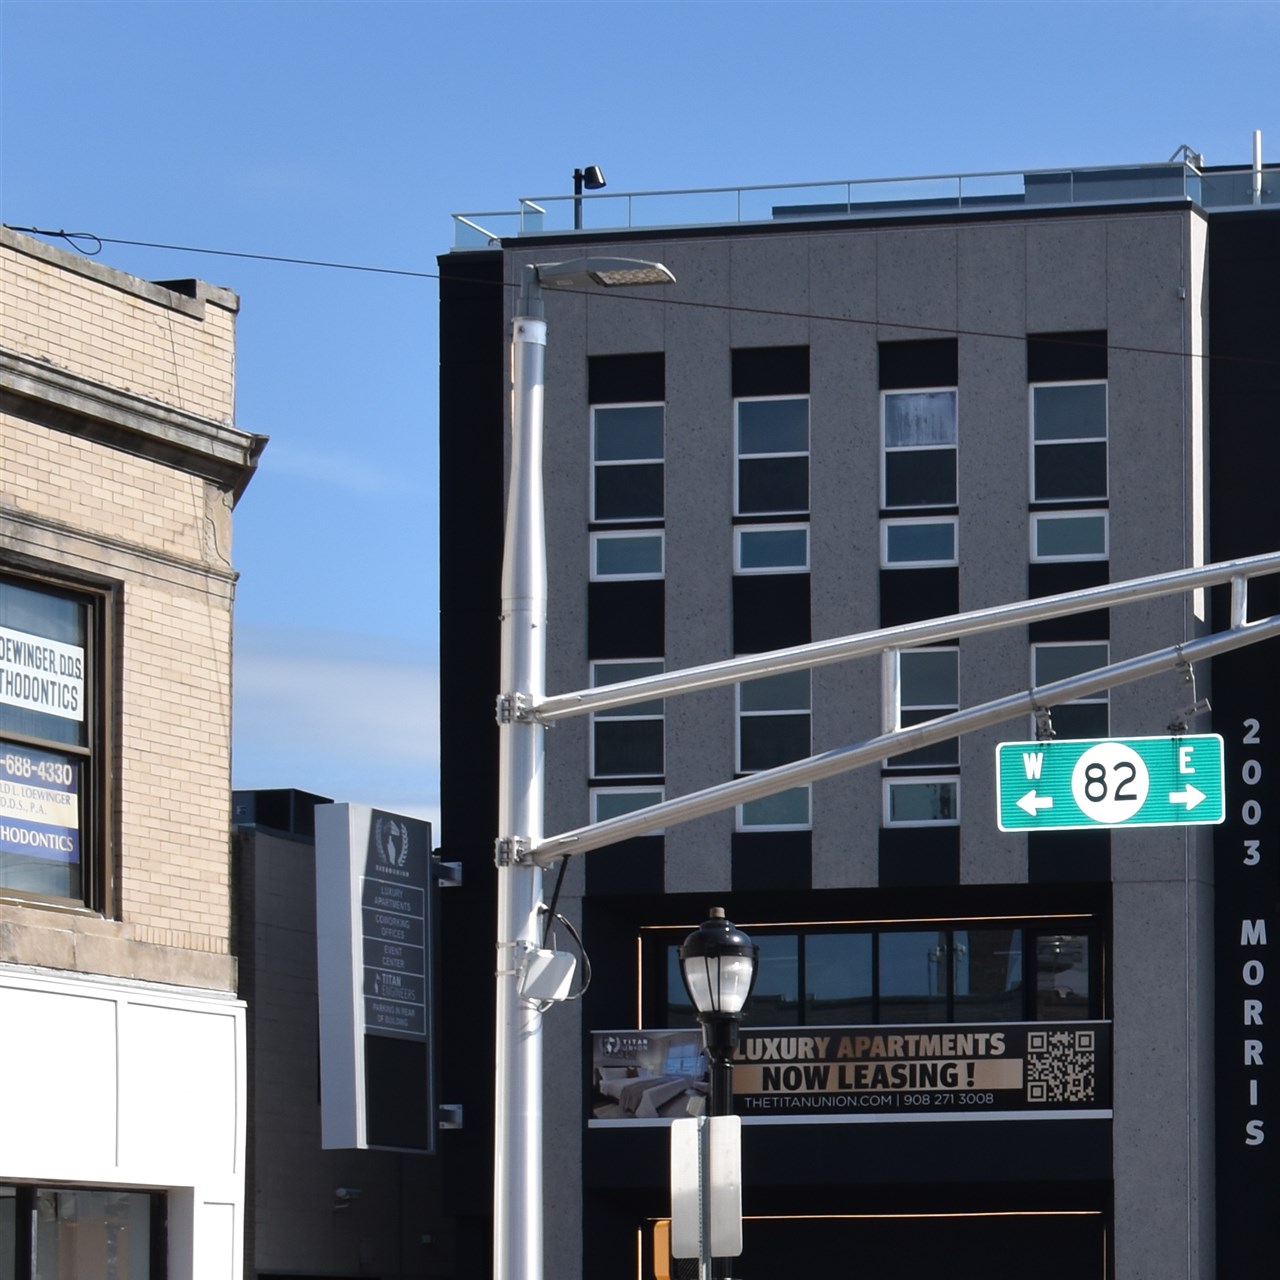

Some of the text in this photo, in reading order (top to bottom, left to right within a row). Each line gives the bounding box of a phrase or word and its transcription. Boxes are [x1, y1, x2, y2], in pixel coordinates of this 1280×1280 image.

[1022, 751, 1044, 780] W
[1178, 746, 1195, 774] E
[1084, 760, 1138, 803] 82
[1241, 717, 1262, 866] 2003
[382, 973, 402, 987] TITAN
[732, 1032, 1006, 1061] LUXURY APARTMENTS
[1240, 919, 1267, 1146] MORRIS
[762, 1064, 831, 1092] NOW
[838, 1062, 959, 1090] LEASING
[744, 1092, 994, 1109] THETITANUNION.COM 908 271 3008
